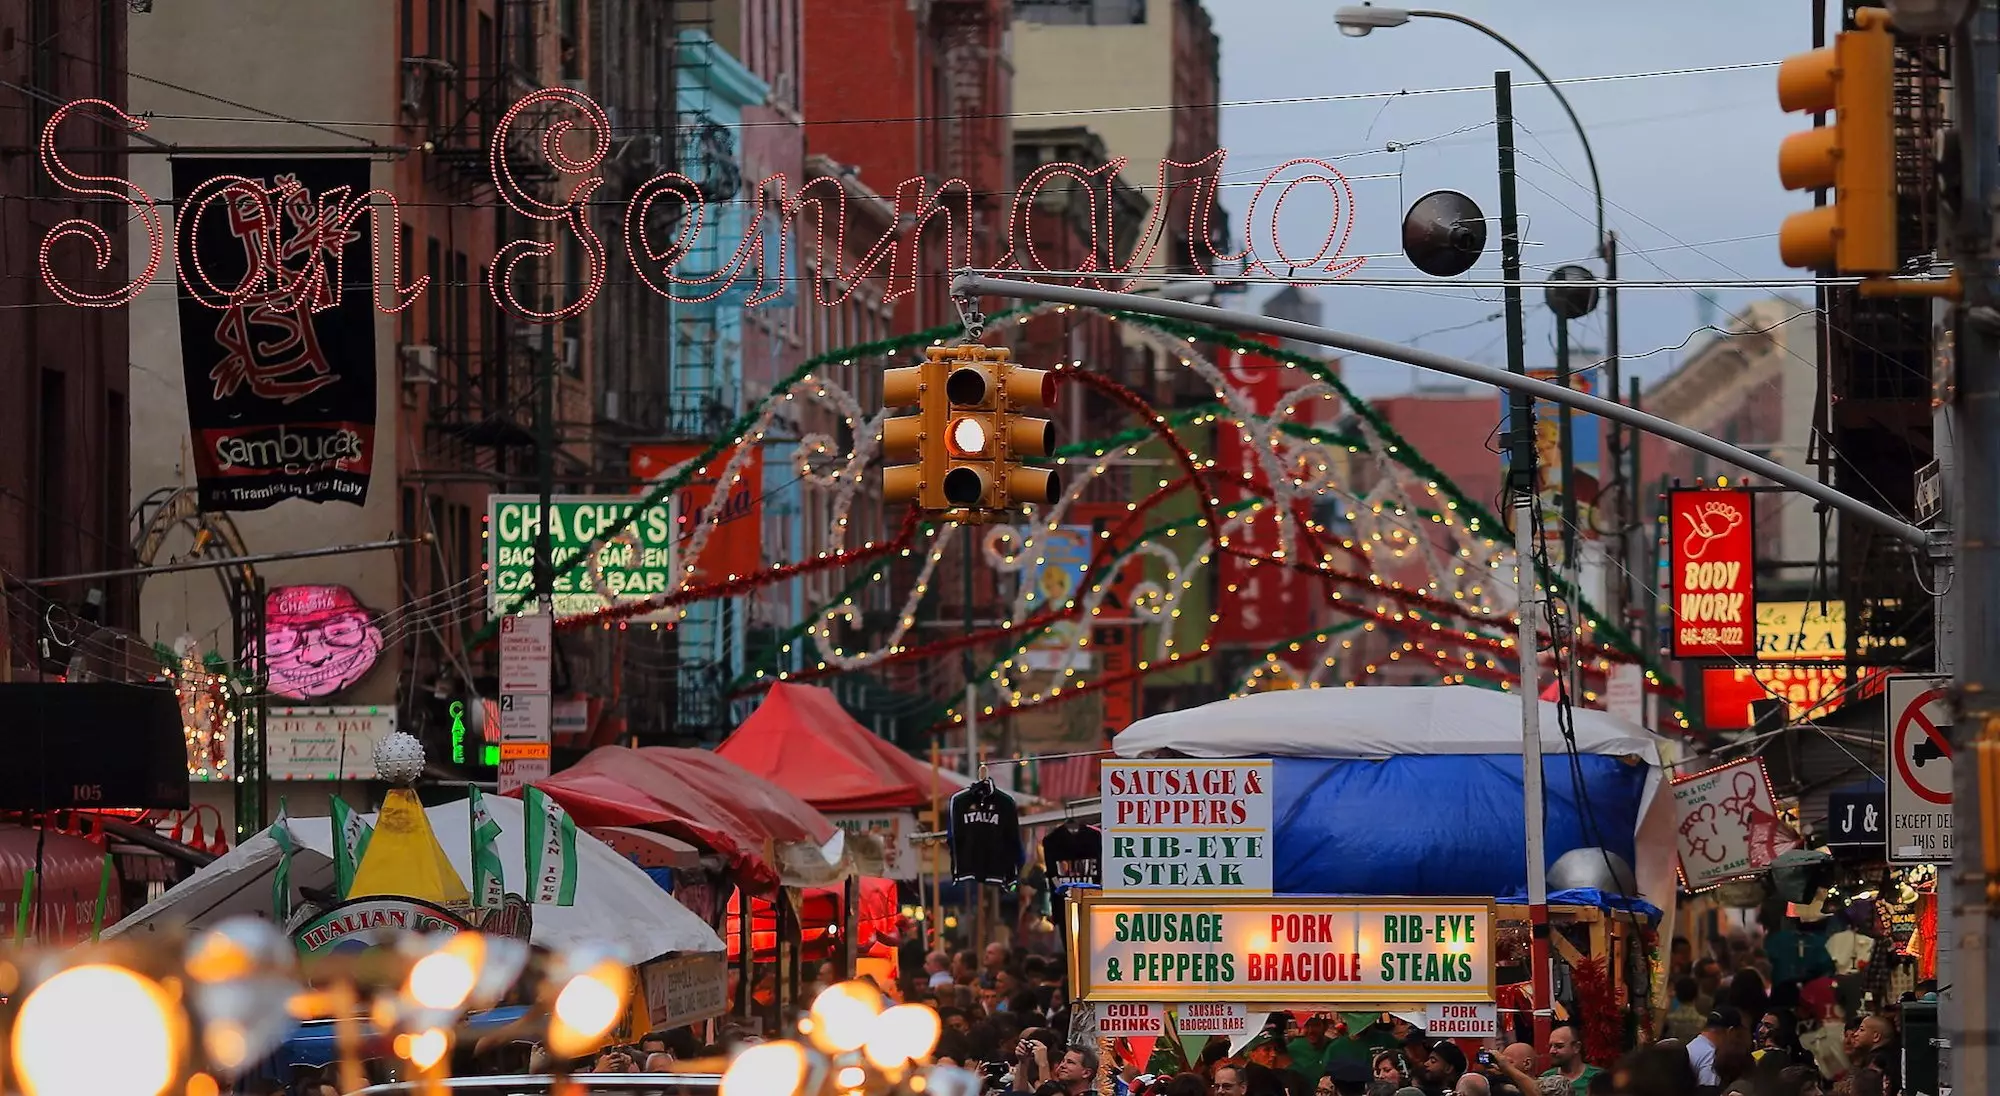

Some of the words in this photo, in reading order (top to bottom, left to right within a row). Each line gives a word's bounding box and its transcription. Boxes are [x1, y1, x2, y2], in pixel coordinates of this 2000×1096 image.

[40, 98, 431, 313] San
[488, 85, 1367, 318] Gennaro
[215, 424, 364, 471] Sambuca's
[332, 479, 363, 496] Italy
[500, 504, 566, 543] CHA
[499, 547, 588, 567] BACAR
[597, 549, 669, 568] GAREN
[498, 570, 574, 591] CAE
[606, 572, 666, 592] BAR
[1684, 561, 1741, 590] BODY
[1680, 592, 1745, 623] WORK
[72, 784, 102, 800] 105
[1109, 769, 1237, 796] SAUSAGE
[1244, 769, 1264, 795] &
[963, 812, 1000, 825] ITALIA
[1116, 799, 1247, 826] PEPPERS
[1842, 804, 1855, 833] J
[1863, 803, 1879, 832] &
[1894, 814, 1932, 829] EXCEPT
[1112, 835, 1264, 859] RIB-EYE
[1912, 834, 1936, 849] THIS
[1122, 863, 1245, 886] STEAK
[75, 895, 119, 924] DISCNT
[302, 910, 407, 951] ITALIAN
[1115, 913, 1223, 943] SAUSAGE
[1271, 914, 1333, 943] PORK
[1384, 914, 1475, 943] RIB-EYE
[1107, 958, 1123, 982] &
[1133, 953, 1235, 982] PEPPERS
[1248, 953, 1361, 982] BRACIOLE
[1380, 953, 1472, 982] STEAKS
[1107, 1004, 1138, 1017] COLD
[1179, 1020, 1220, 1031] BROCCOLI
[1222, 1017, 1244, 1030] RABE
[1188, 1004, 1224, 1017] SAUSAGE
[1227, 1005, 1233, 1015] &
[1441, 1005, 1478, 1018] PORK
[1100, 1018, 1160, 1031] DRINKS
[1429, 1020, 1494, 1032] BRACIOLE
